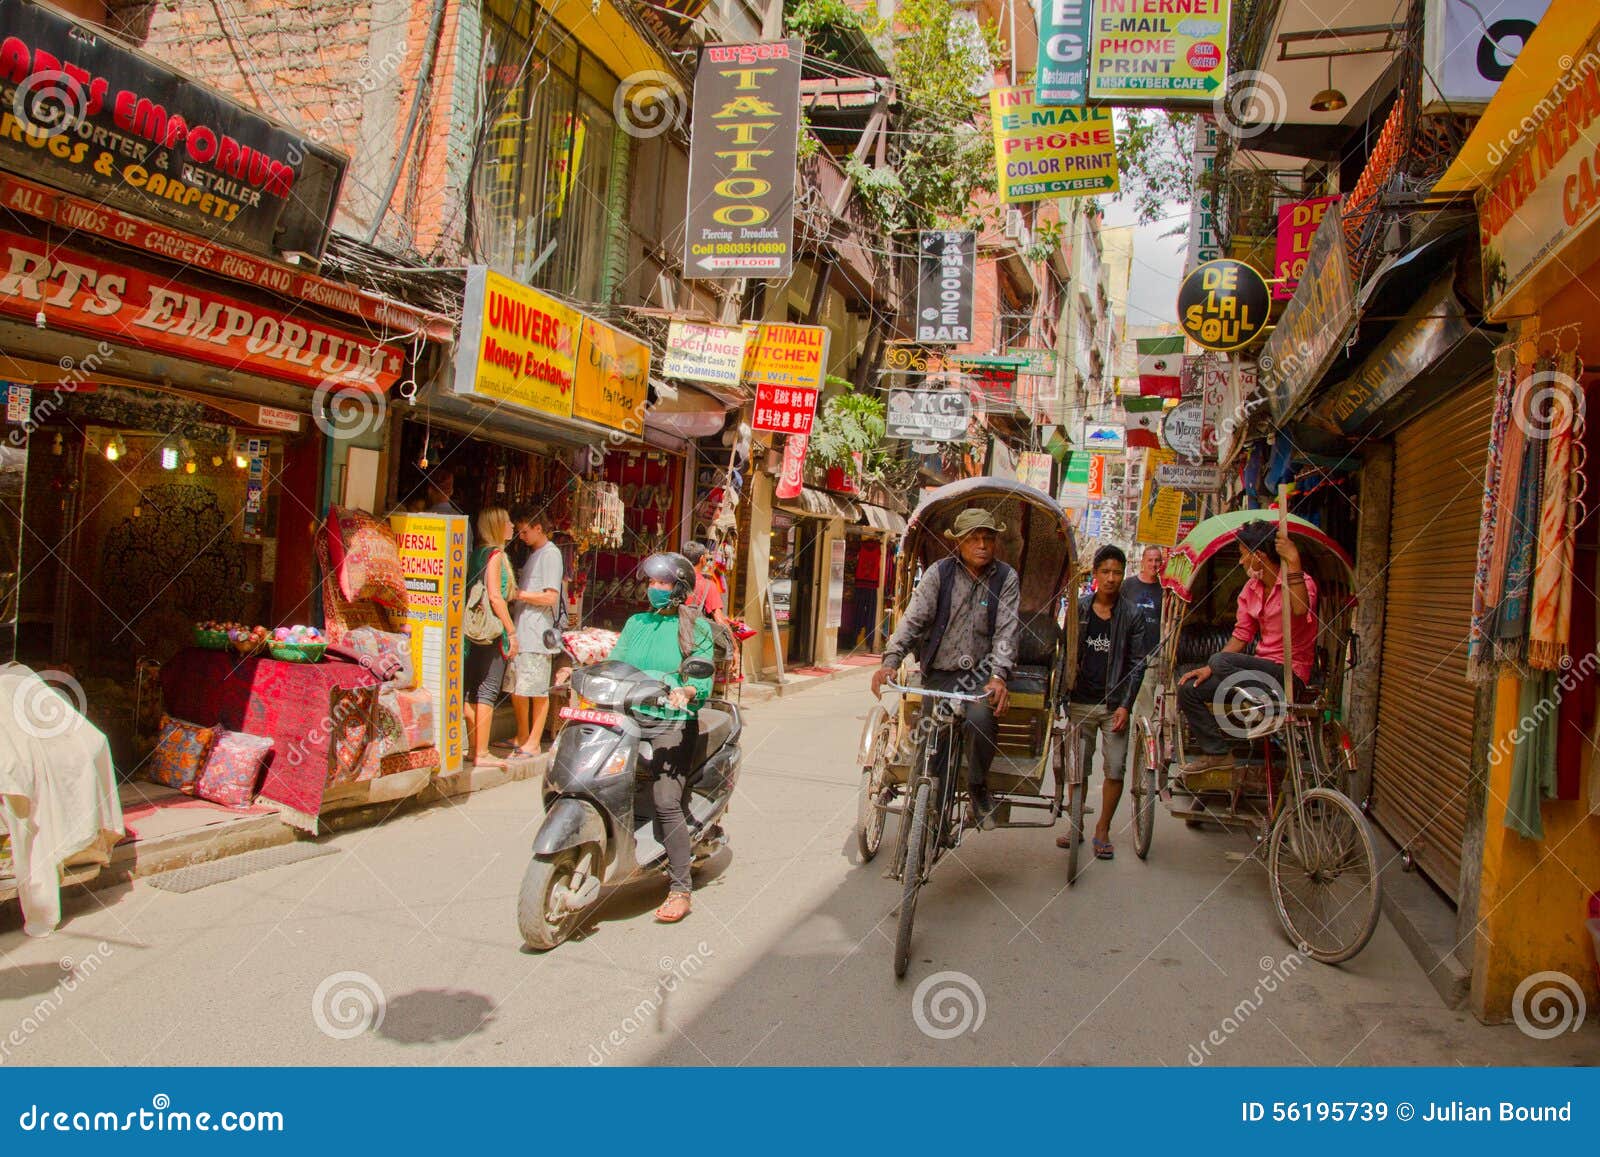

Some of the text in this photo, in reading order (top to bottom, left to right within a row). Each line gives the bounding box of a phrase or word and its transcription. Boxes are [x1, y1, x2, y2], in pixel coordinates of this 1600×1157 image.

[1102, 0, 1220, 14] INTERNET
[1100, 17, 1172, 33] E-MAIL
[708, 43, 790, 64] urgen
[1099, 39, 1176, 54] PHONE
[1195, 45, 1214, 55] SIM
[1098, 58, 1176, 74] PRINT
[1190, 57, 1218, 68] CARD
[1042, 67, 1083, 86] Restaurant
[1099, 76, 1205, 89] MSN CYBER CAFE
[1000, 90, 1035, 107] INT
[1002, 107, 1109, 131] E-MAIL
[113, 90, 295, 199] EMPORIUM
[711, 68, 783, 226] TATTOO
[1004, 129, 1111, 154] PHONE
[0, 112, 89, 164] RUGS
[93, 151, 114, 177] &
[123, 164, 242, 222] CARPETS
[1006, 158, 1060, 178] COLOR
[181, 162, 262, 209] RETAILER
[1011, 177, 1105, 196] MSN CYBER
[1294, 203, 1327, 227] DE
[10, 188, 44, 216] ALL
[114, 221, 138, 243] OF
[220, 254, 257, 286] RUGS
[258, 268, 292, 292] AND
[702, 227, 779, 241] Piercing Dreadlock
[691, 244, 715, 255] Cell
[940, 232, 963, 325] BAMBOOZE
[1203, 268, 1238, 291] DE
[1280, 258, 1308, 282] SO
[1207, 290, 1237, 319] LA
[0, 247, 388, 384] RTS EMPORIUM
[1186, 304, 1254, 343] SOUL
[685, 324, 730, 339] MONEY
[766, 326, 823, 347] HIMALI
[919, 326, 969, 340] BAR
[671, 338, 740, 356] EXCHANGE
[744, 346, 819, 363] KITCHEN
[484, 336, 523, 379] Money
[683, 364, 737, 379] COMMISSION
[395, 533, 438, 551] IVERSAL
[401, 556, 444, 576] EXCHANGE
[406, 578, 437, 592] mission
[408, 593, 443, 607] XCHANGER
[447, 532, 464, 758] MONEY EXCHANGE
